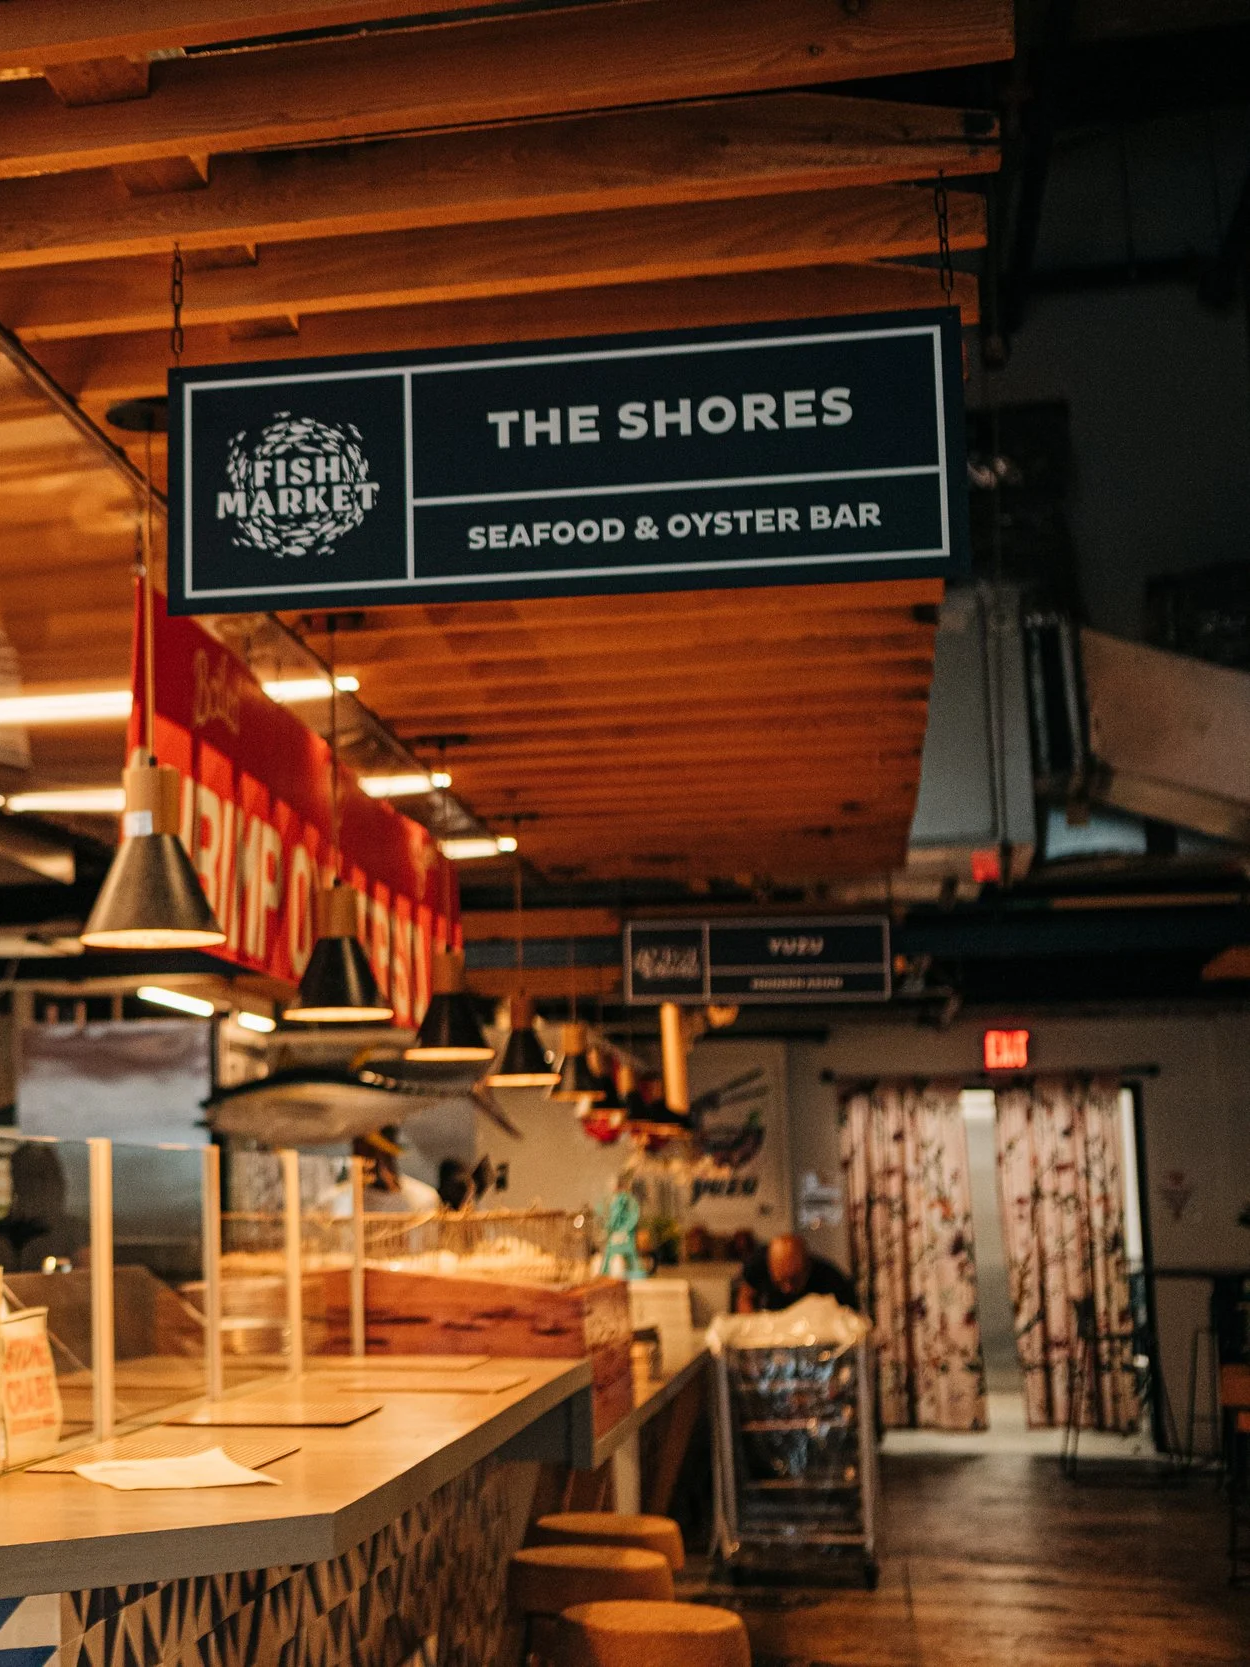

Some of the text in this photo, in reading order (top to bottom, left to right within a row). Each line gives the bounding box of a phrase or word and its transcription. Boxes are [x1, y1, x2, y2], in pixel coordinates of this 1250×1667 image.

[487, 386, 853, 449] THE SHORES
[253, 455, 341, 487] FISH
[216, 481, 381, 520] MARKET
[468, 501, 882, 550] SEAFOOD & OYSTER BAR
